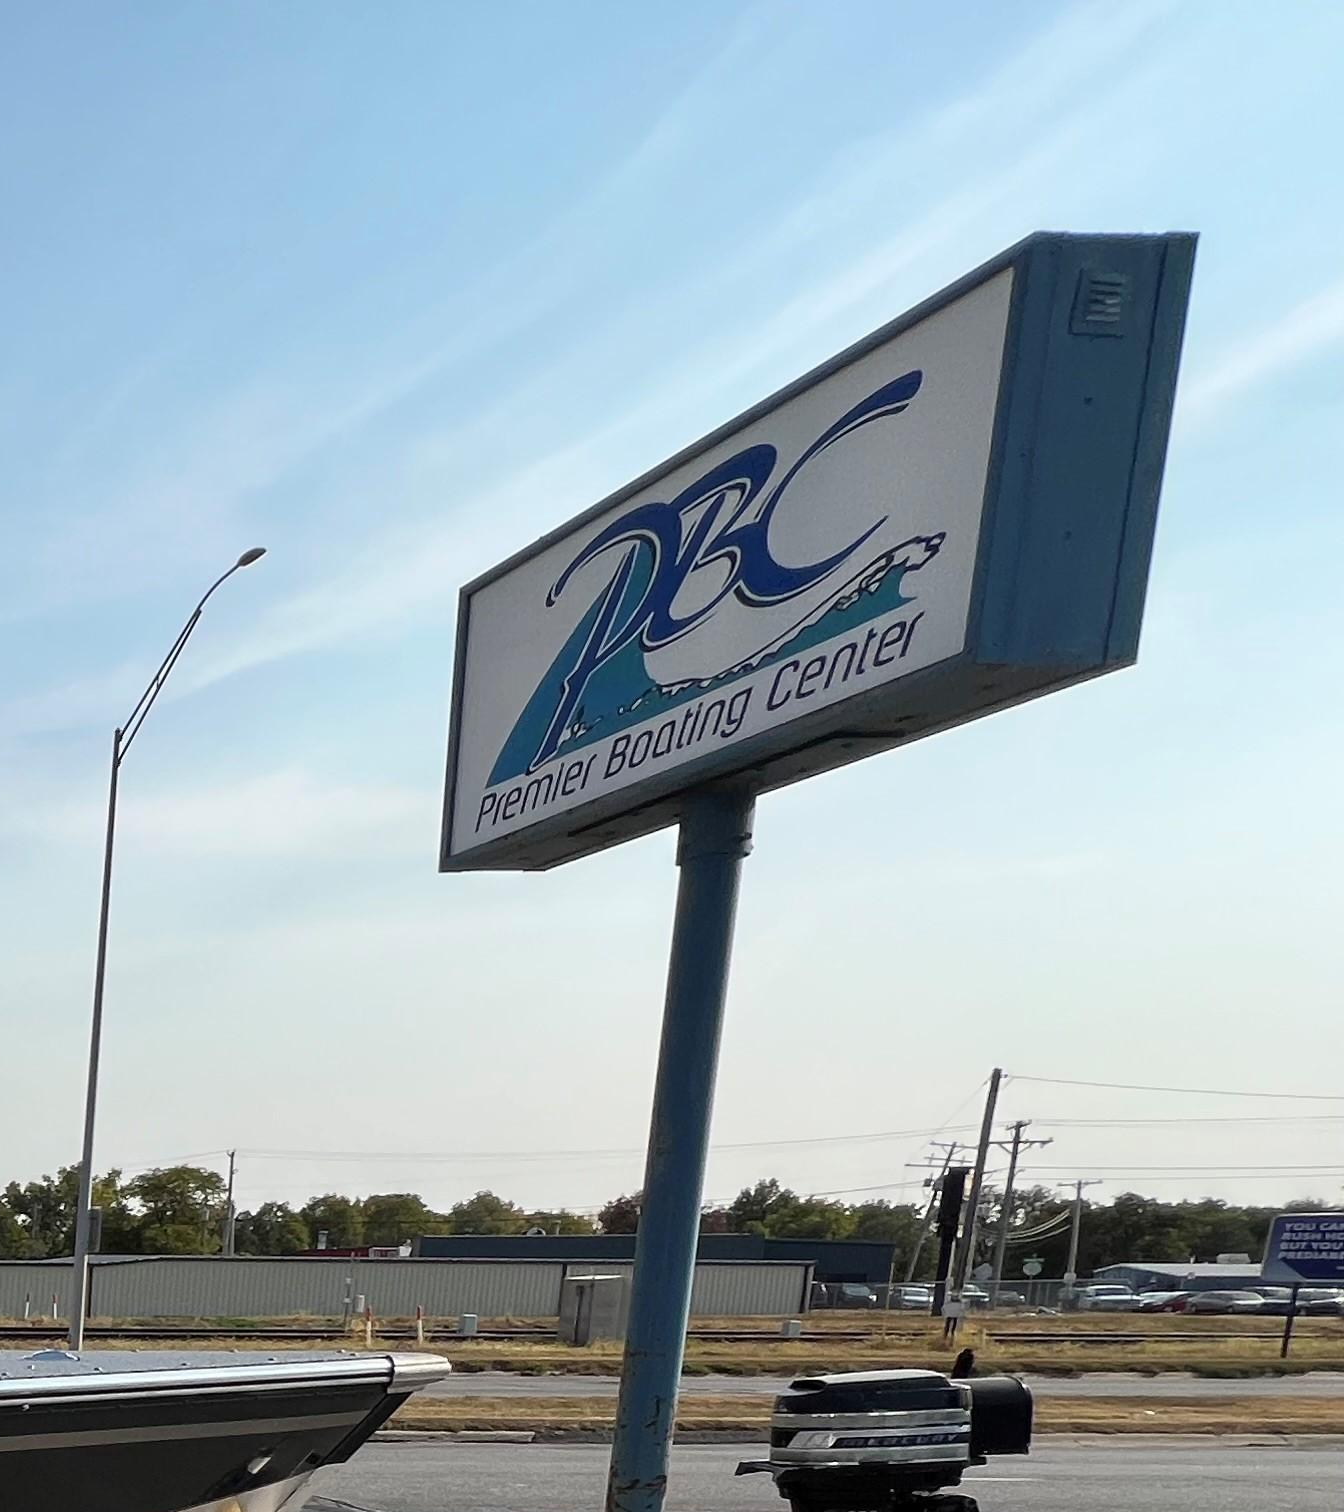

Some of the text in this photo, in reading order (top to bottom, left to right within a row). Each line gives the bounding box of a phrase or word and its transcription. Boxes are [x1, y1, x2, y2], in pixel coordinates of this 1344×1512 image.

[545, 369, 924, 774] PBC
[474, 611, 925, 834] Premier Boating Center
[1285, 1222, 1316, 1231] YOU
[1280, 1232, 1322, 1241] RUSH
[1280, 1241, 1343, 1250] BUT YOU
